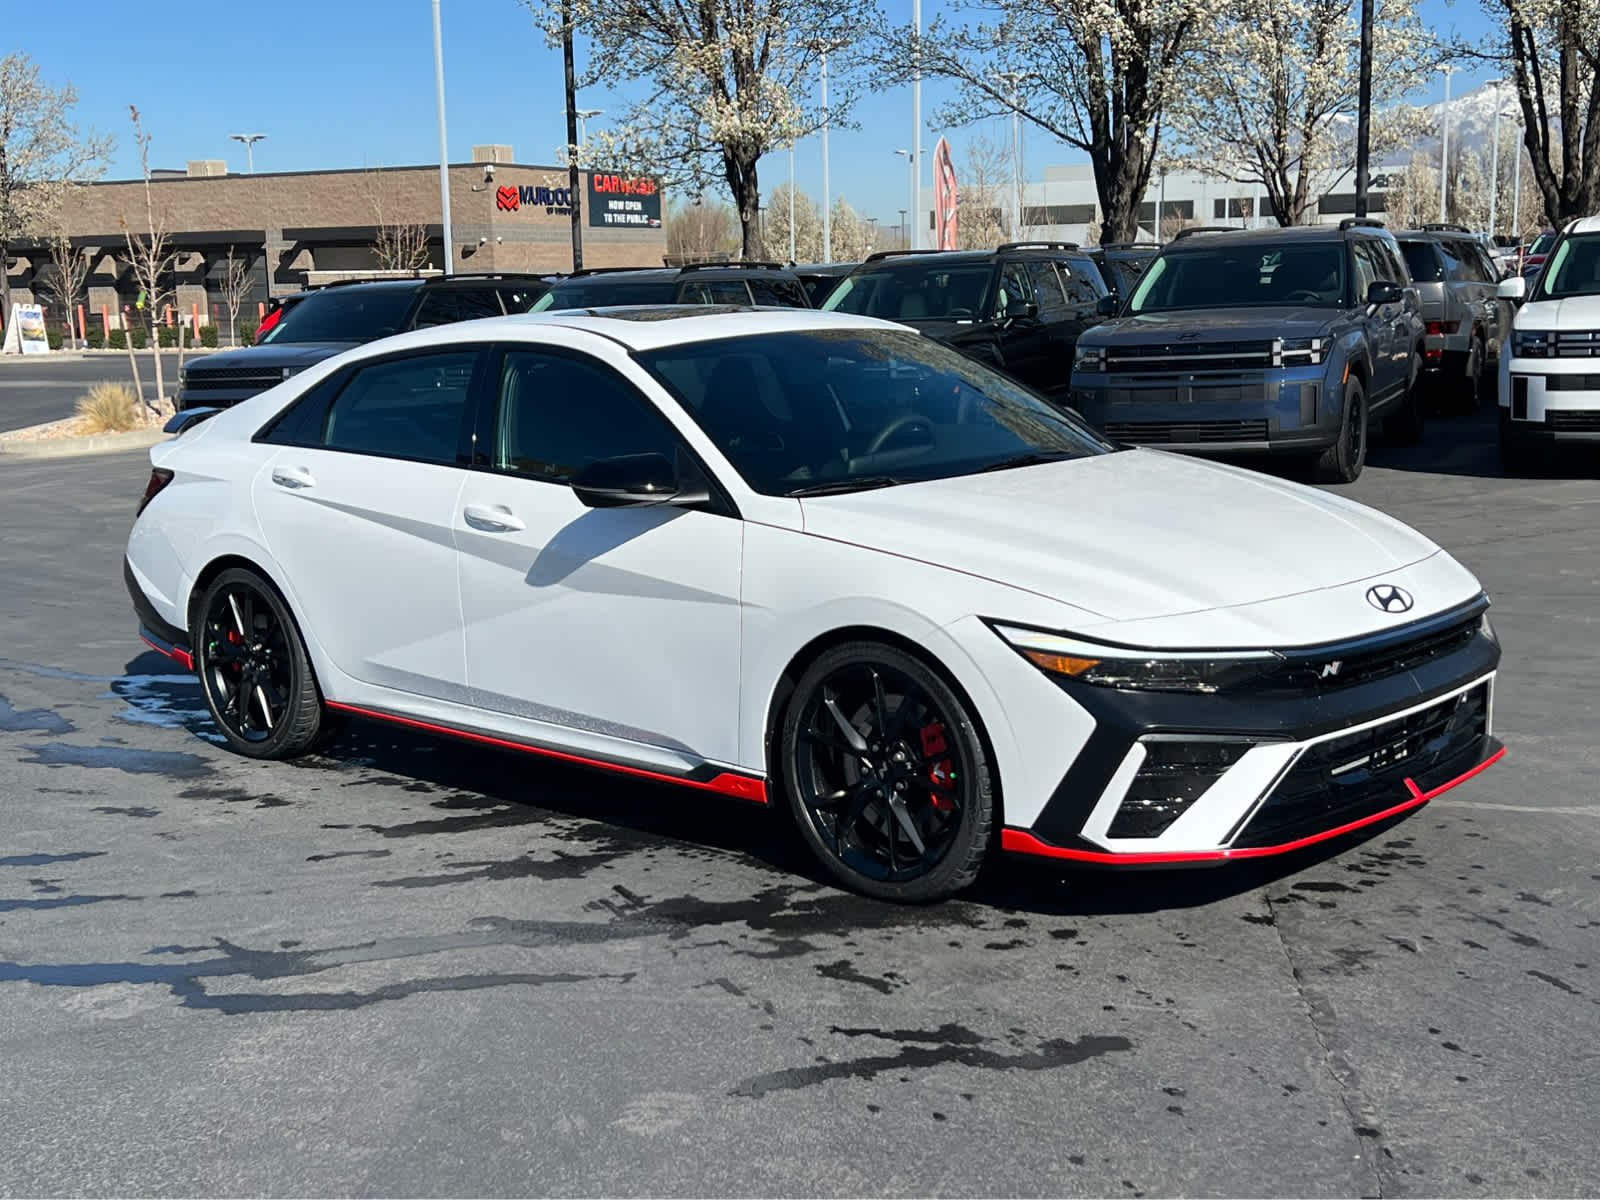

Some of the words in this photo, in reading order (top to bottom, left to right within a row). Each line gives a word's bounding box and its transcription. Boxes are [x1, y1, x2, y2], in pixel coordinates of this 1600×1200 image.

[608, 199, 624, 210] NOW
[625, 200, 642, 211] OPEN
[603, 213, 612, 223] TO
[613, 213, 626, 223] THE
[626, 214, 649, 224] PUBLIC
